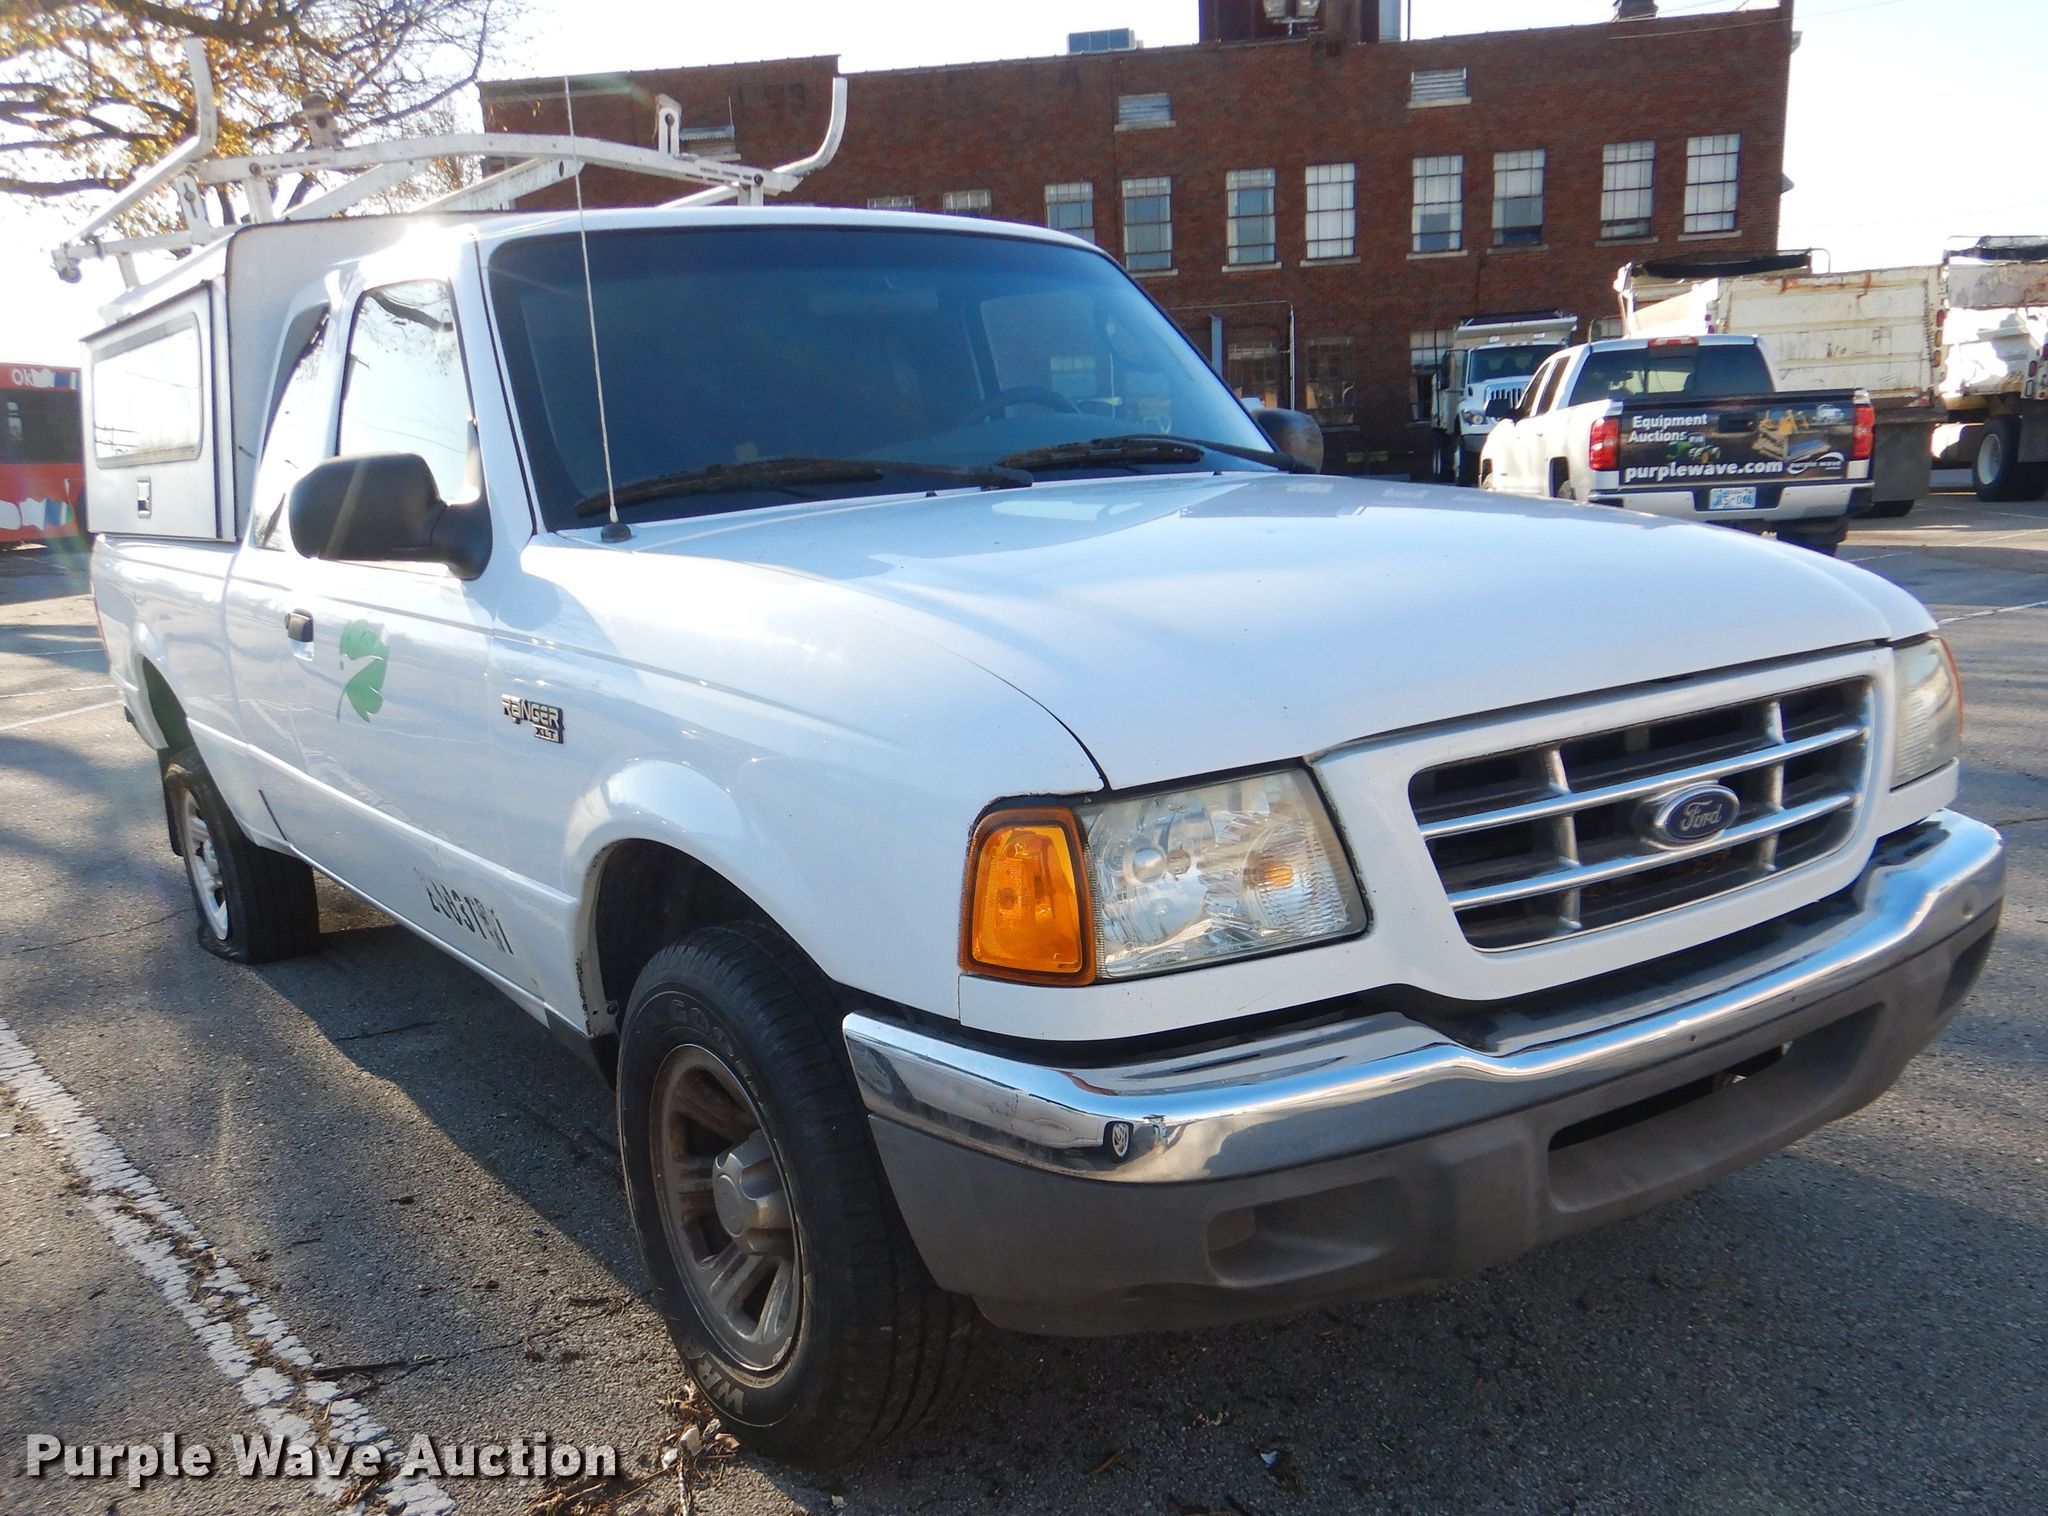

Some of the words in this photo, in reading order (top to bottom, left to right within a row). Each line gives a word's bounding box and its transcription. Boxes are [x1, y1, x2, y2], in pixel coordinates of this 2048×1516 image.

[1632, 413, 1708, 430] Equipment
[1628, 430, 1687, 443] Auctions
[1625, 460, 1784, 483] purplewave.com
[501, 694, 564, 729] RANGER
[535, 726, 559, 740] XLT
[1680, 799, 1723, 832] Ford
